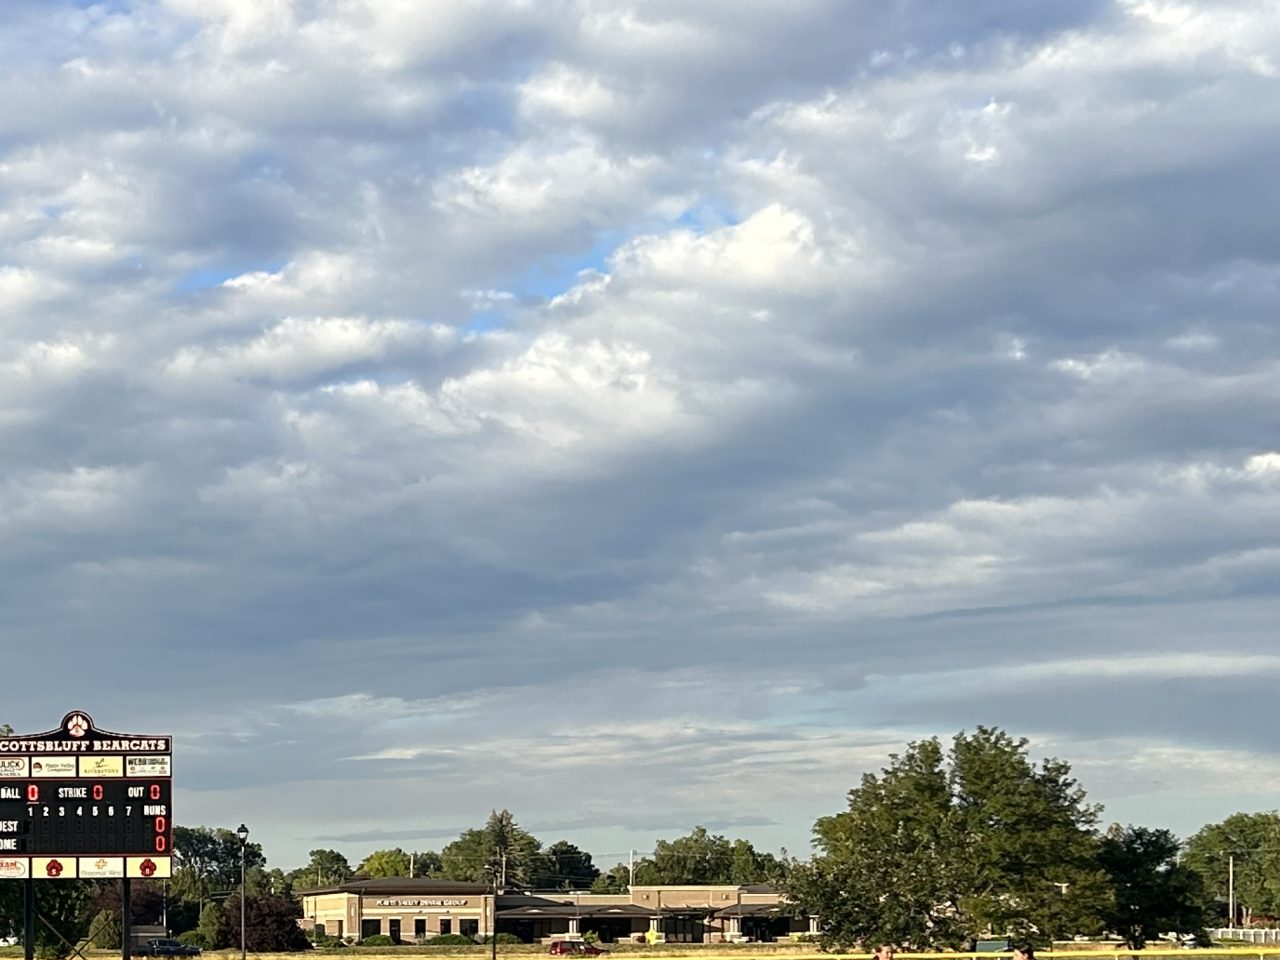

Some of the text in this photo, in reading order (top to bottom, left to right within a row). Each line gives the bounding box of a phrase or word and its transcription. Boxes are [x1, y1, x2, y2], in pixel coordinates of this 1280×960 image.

[93, 739, 166, 751] BEARCATS
[0, 785, 160, 801] BALL 0 STRIKE 0 OUT 0
[28, 805, 167, 816] 1 2 3 4 5 6 7 RUNS
[155, 817, 165, 832] 0
[155, 835, 165, 851] 0
